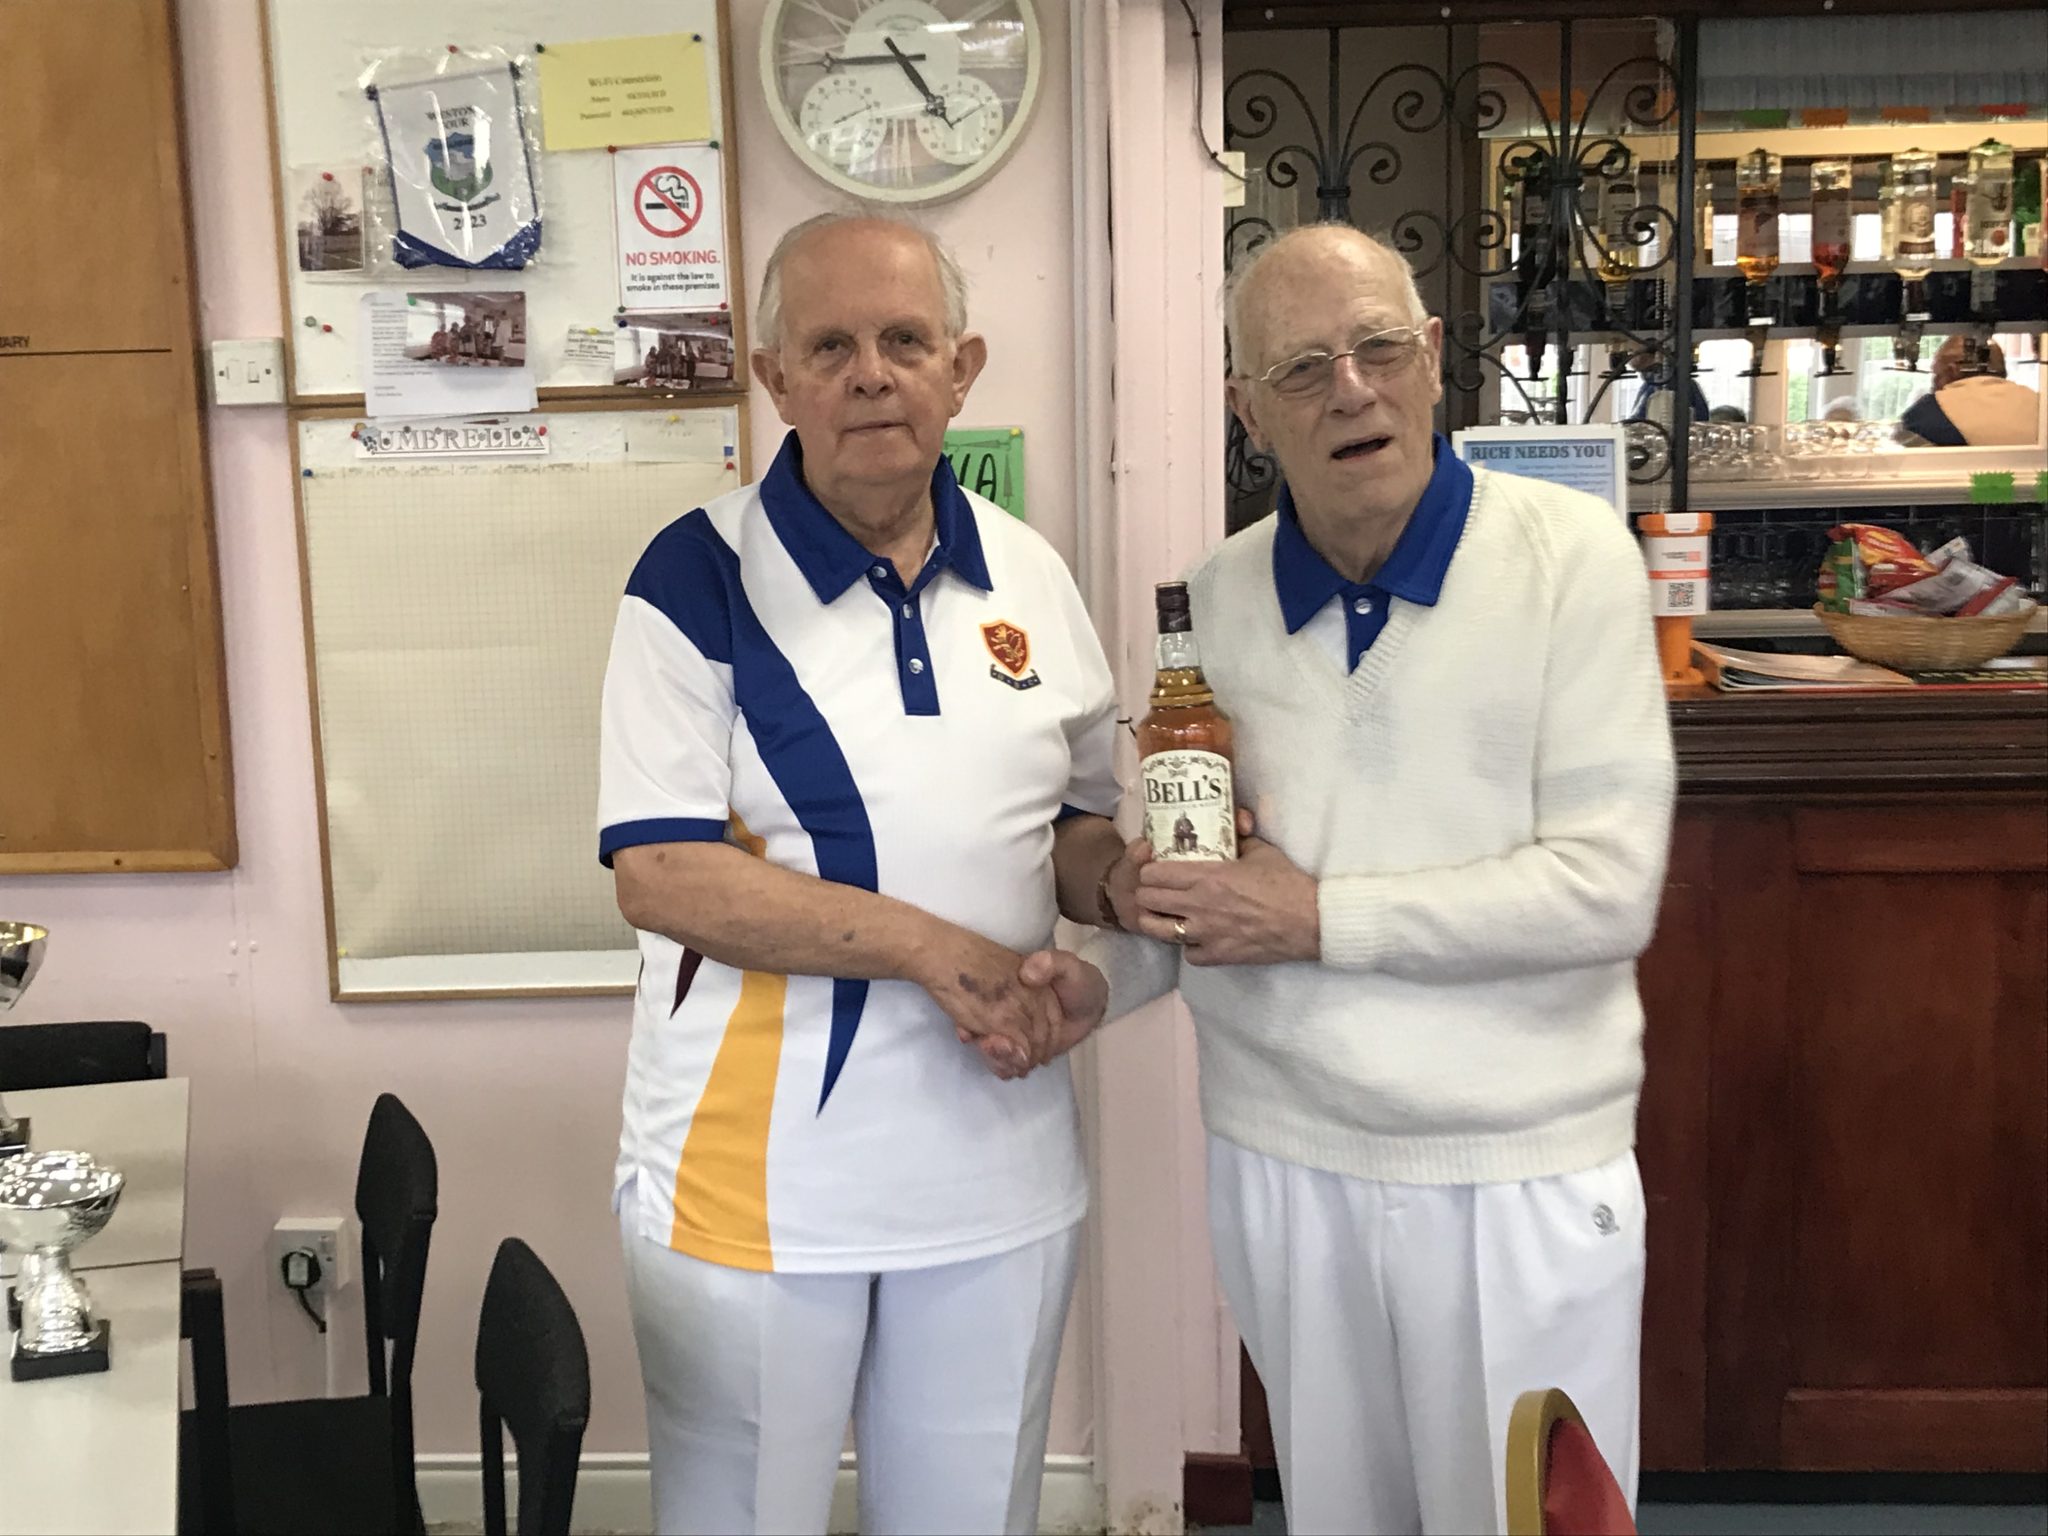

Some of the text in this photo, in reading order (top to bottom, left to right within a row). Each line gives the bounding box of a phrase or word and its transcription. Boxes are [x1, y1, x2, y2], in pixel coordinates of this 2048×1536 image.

[453, 214, 487, 230] 223
[626, 252, 647, 266] NO
[631, 273, 638, 281] It
[639, 273, 646, 281] is
[647, 273, 675, 283] against
[677, 271, 690, 280] the
[691, 272, 704, 280] law
[626, 282, 720, 292] smoke in these premises
[378, 427, 545, 451] UMBRELLA
[1471, 445, 1607, 460] RICH NEEDS YOU
[1145, 774, 1222, 804] BELL'S
